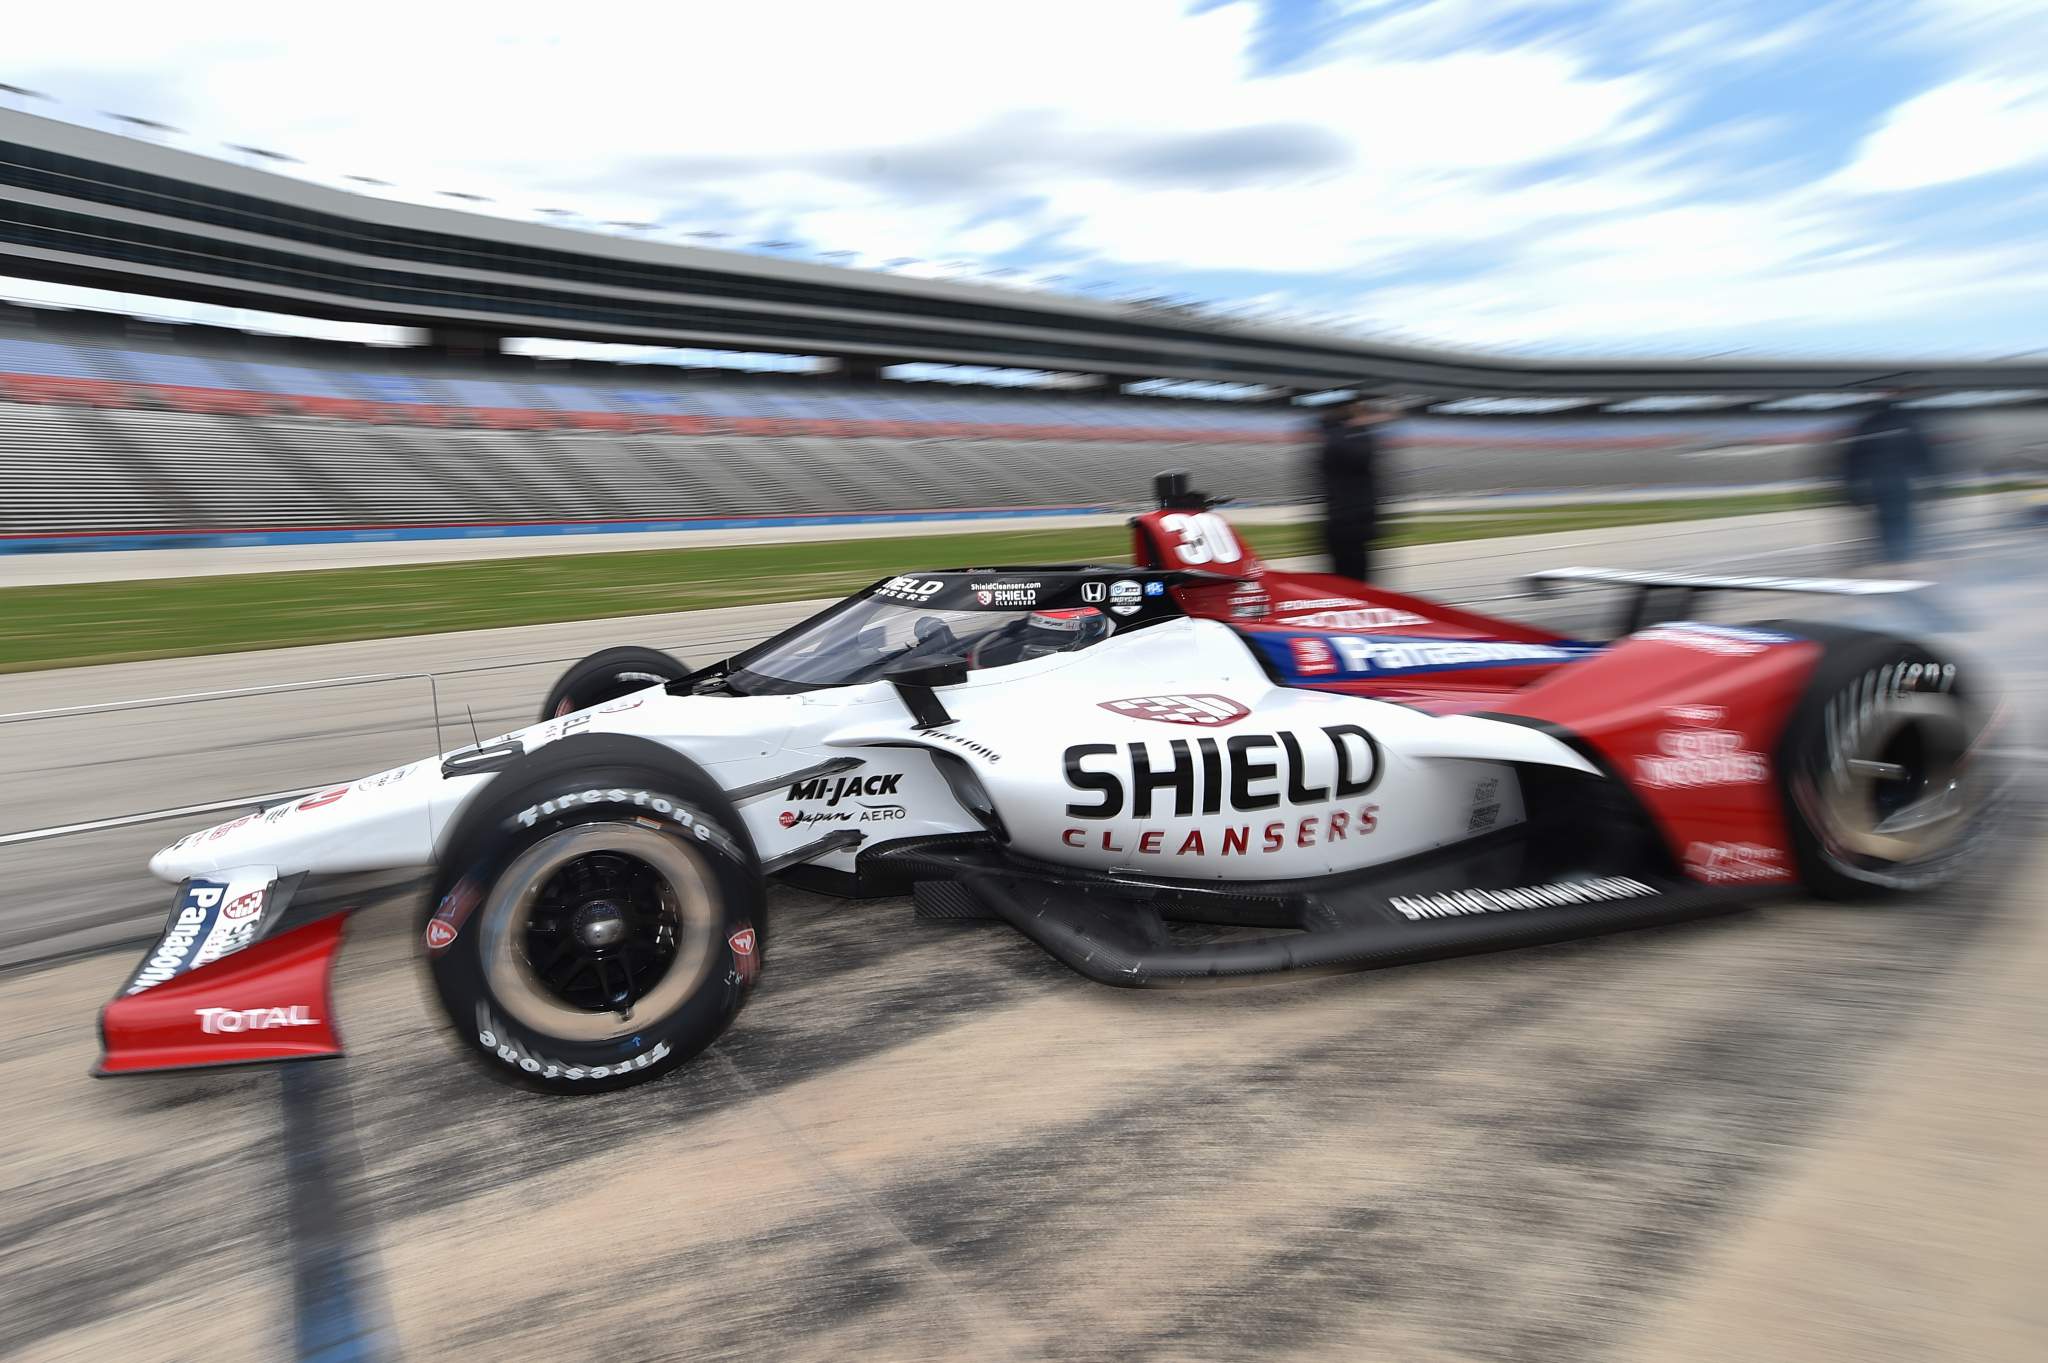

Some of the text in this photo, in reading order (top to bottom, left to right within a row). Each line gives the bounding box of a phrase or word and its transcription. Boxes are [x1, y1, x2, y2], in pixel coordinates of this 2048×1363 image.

[1159, 512, 1242, 566] 30
[994, 589, 1036, 601] SHIELD
[786, 774, 904, 807] MI-JACK
[1062, 724, 1386, 821] SHIELD
[517, 789, 711, 842] Firestone
[859, 808, 906, 822] AERO
[1061, 804, 1380, 857] CLEANSERS
[479, 1040, 671, 1080] Firestone
